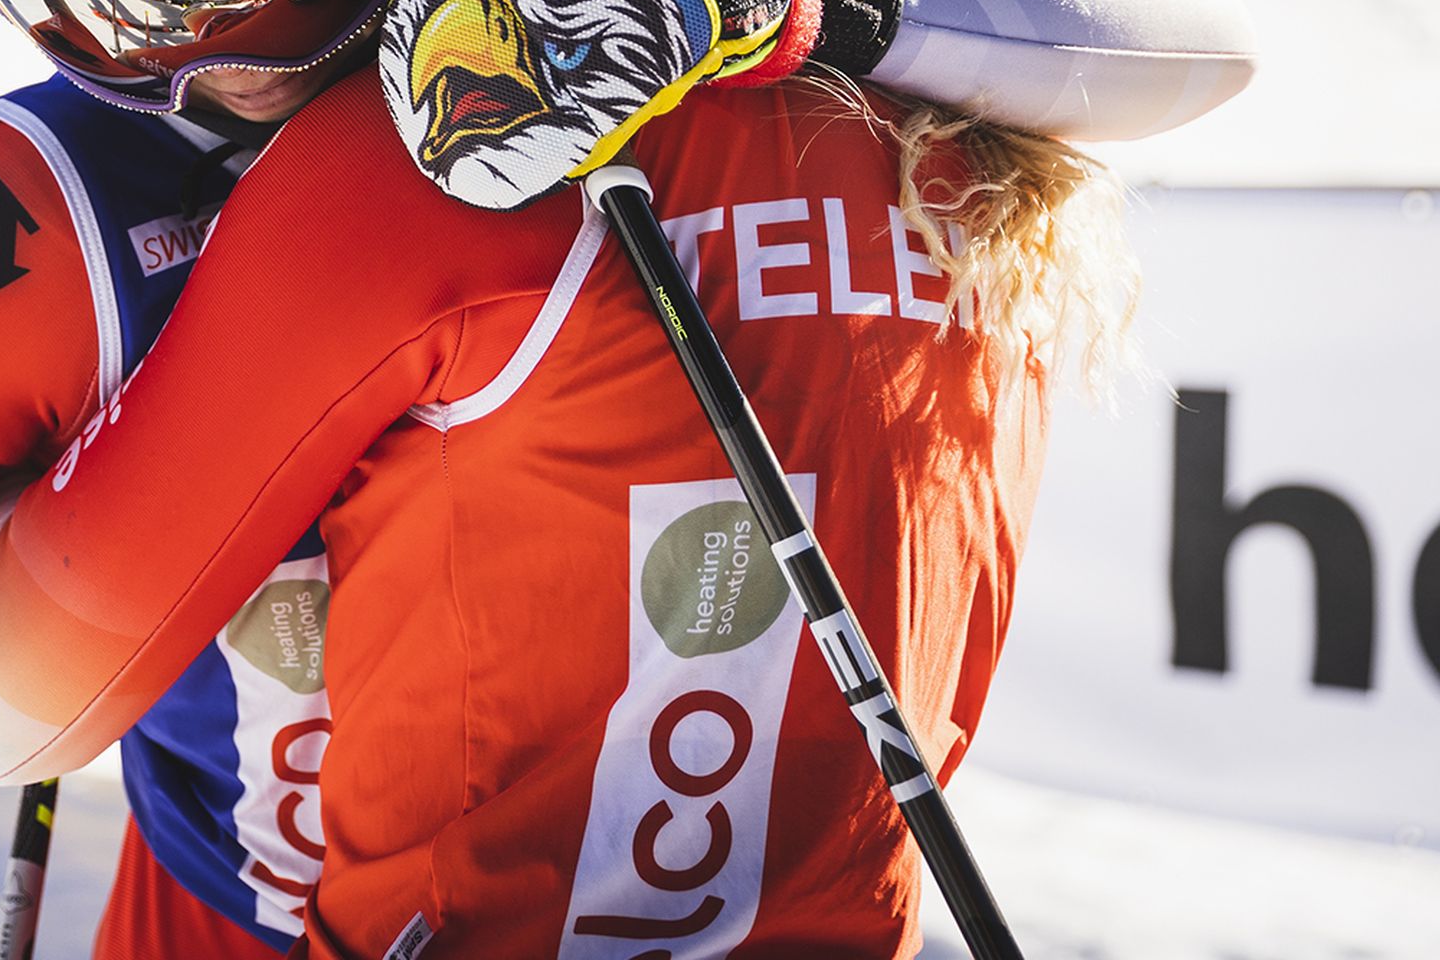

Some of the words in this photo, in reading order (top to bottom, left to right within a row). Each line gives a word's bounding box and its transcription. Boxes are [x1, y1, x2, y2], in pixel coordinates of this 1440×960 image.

[656, 286, 688, 341] NORDIC
[686, 531, 728, 634] heating
[717, 519, 752, 636] solutions
[1171, 386, 1440, 696] h
[271, 601, 302, 669] heating
[295, 590, 318, 680] solutions
[250, 718, 333, 918] lco
[572, 689, 754, 960] lco
